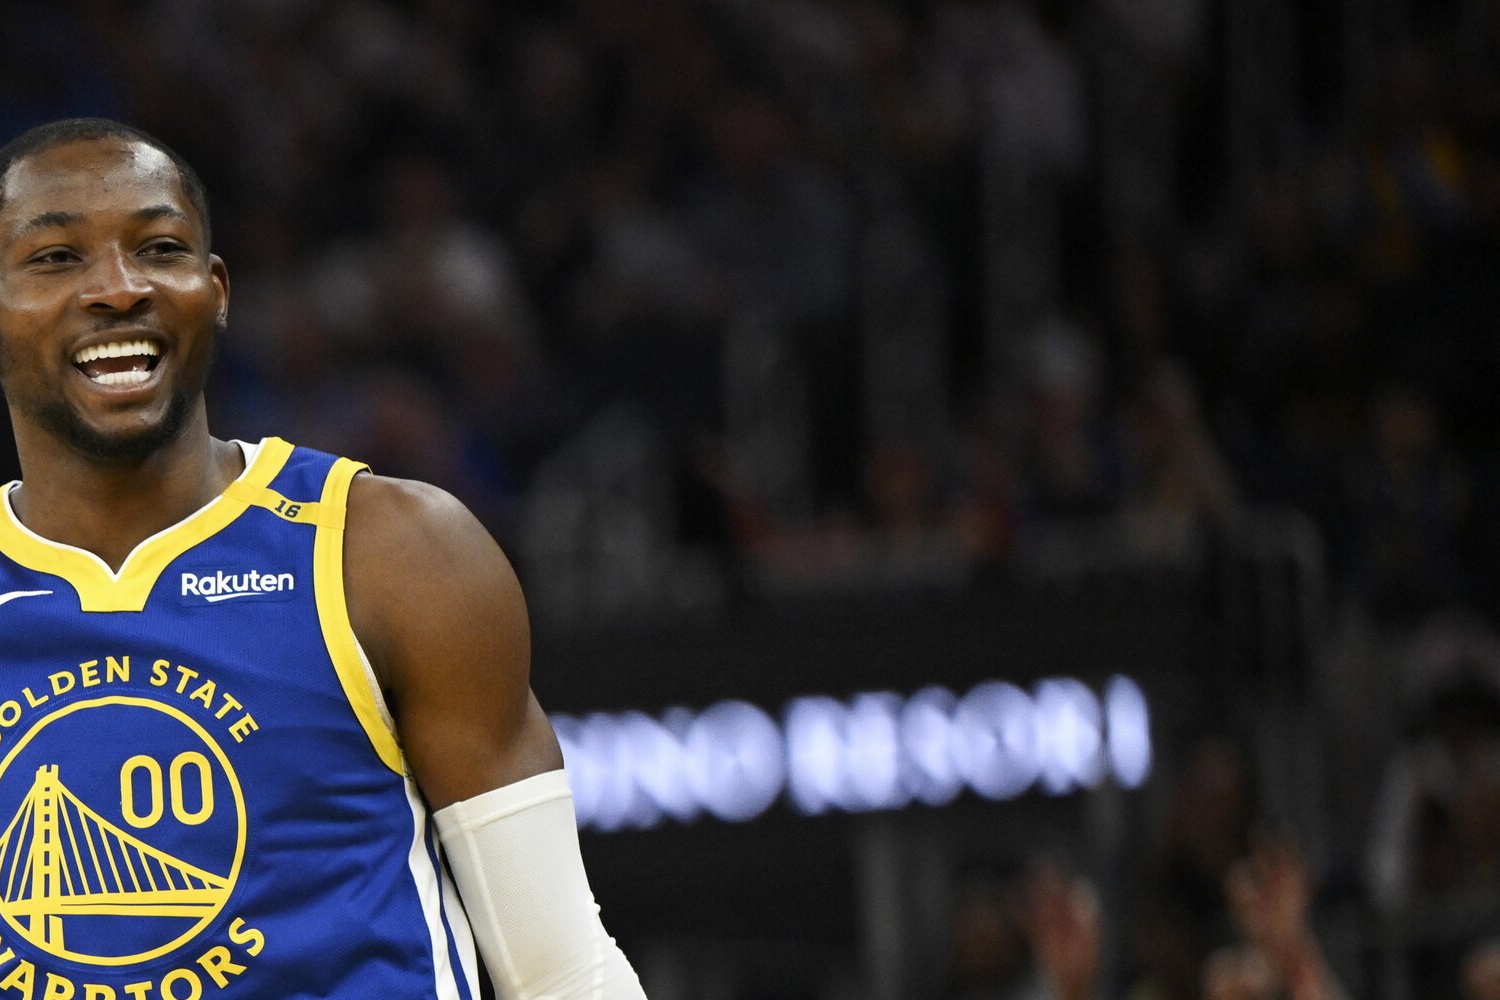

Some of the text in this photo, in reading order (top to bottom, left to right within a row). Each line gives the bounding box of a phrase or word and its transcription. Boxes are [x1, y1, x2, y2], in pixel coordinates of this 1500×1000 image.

[274, 499, 302, 519] 16
[181, 569, 295, 597] Rakuten
[149, 658, 260, 744] STATE
[120, 751, 215, 829] 00
